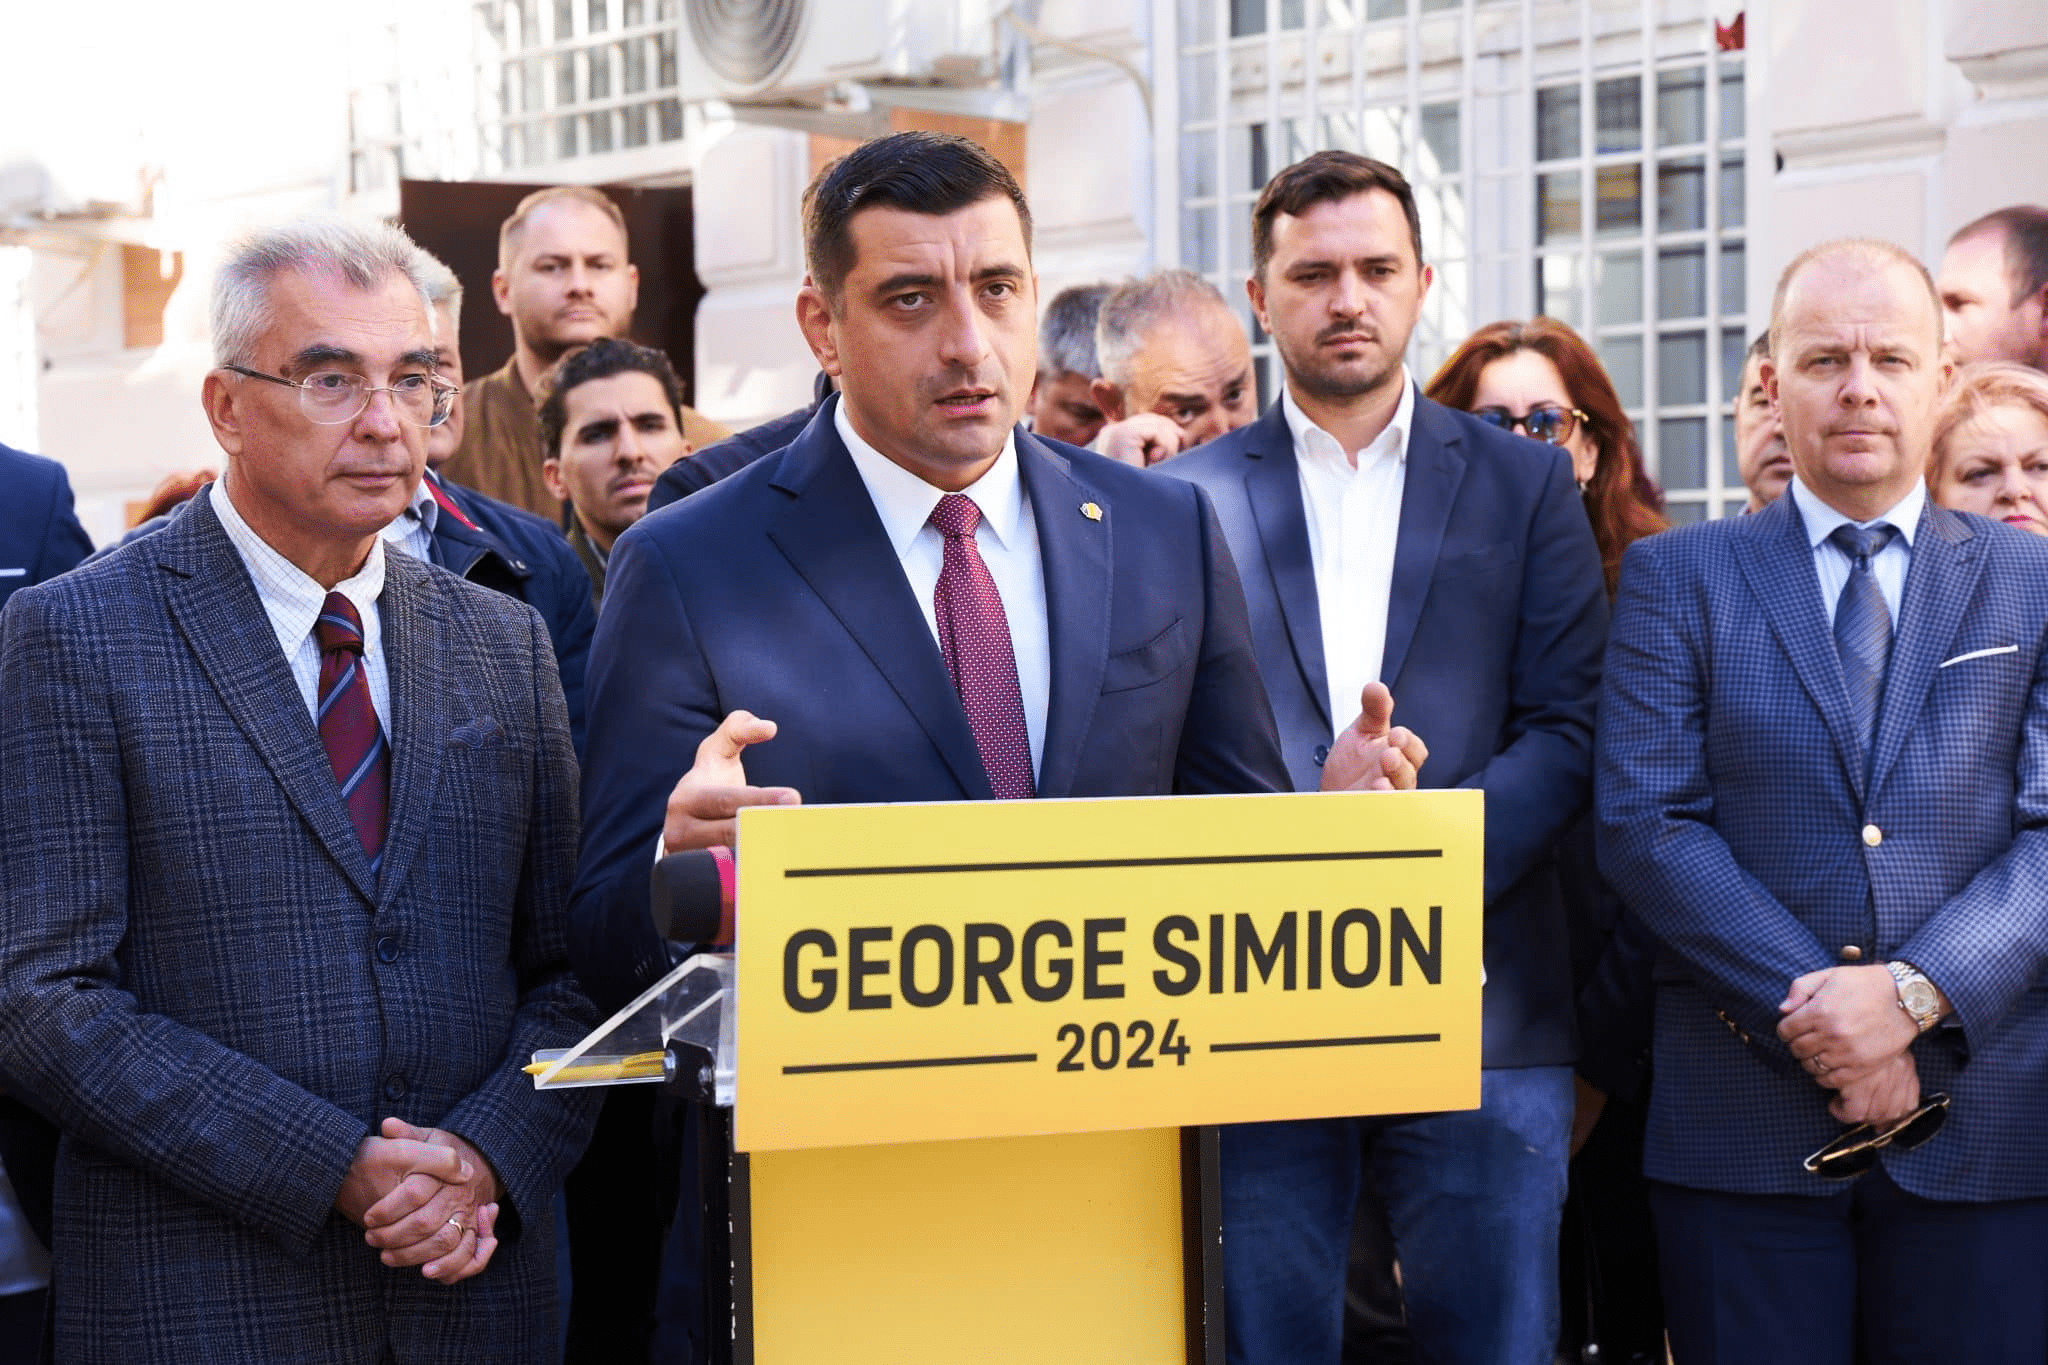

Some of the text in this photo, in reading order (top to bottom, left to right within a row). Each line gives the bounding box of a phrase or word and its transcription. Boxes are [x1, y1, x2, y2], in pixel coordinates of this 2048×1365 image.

[783, 905, 1443, 1014] GEORGE SIMION
[1056, 1018, 1191, 1073] 2024
